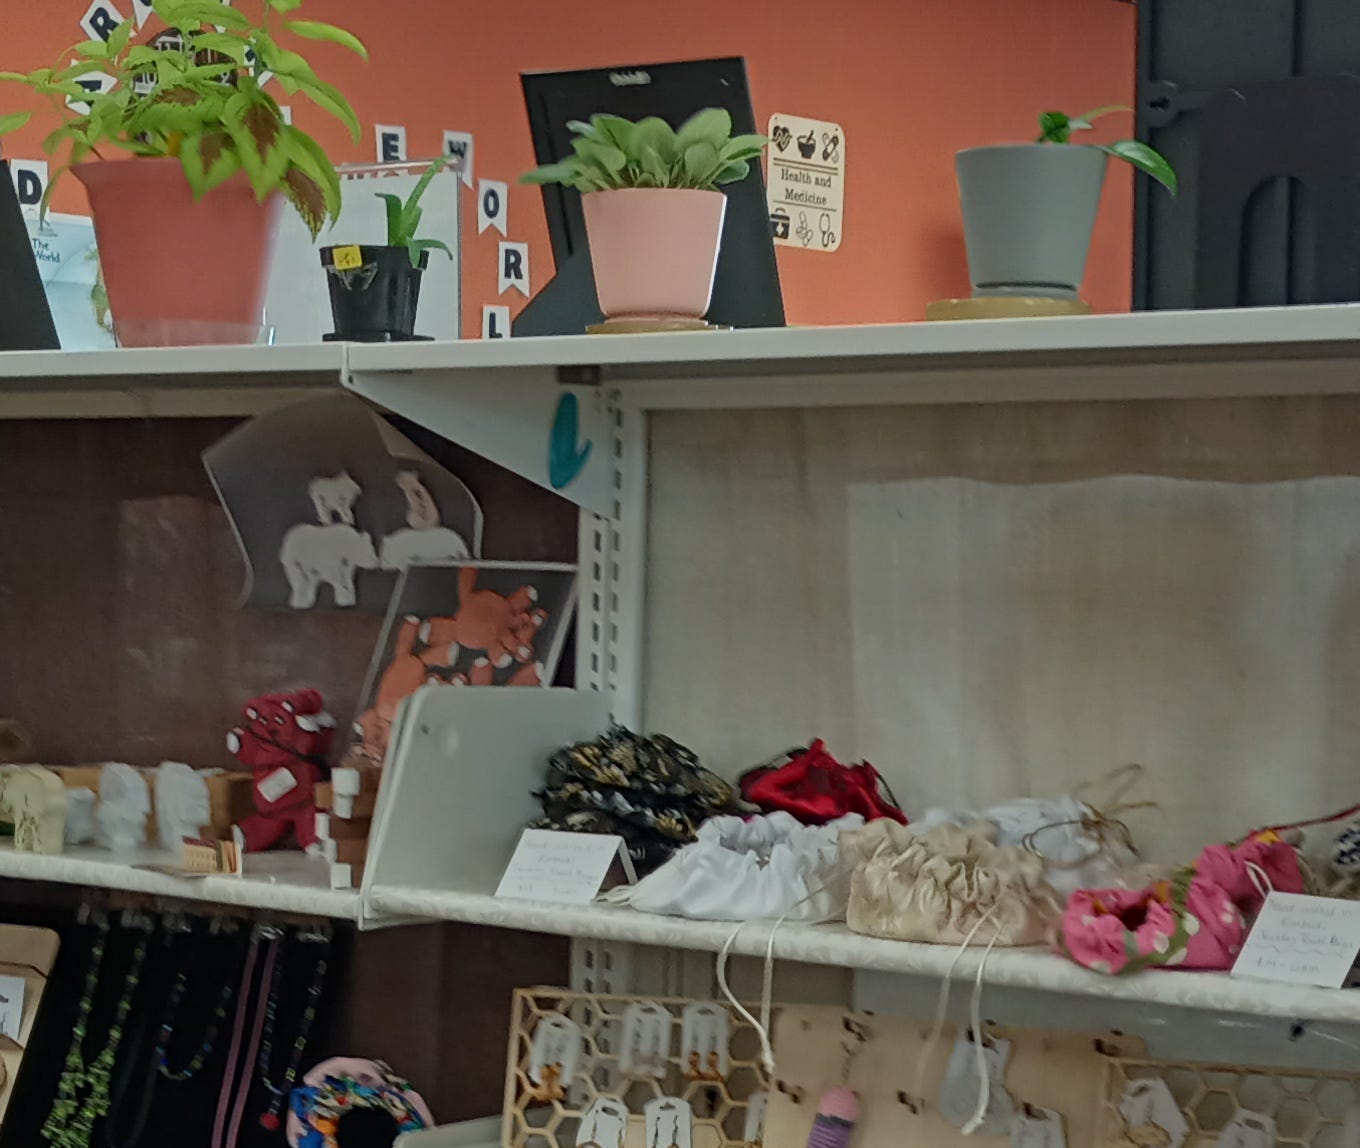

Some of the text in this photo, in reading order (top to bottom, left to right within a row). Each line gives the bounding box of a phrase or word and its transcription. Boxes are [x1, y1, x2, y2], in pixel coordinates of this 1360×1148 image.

[780, 167, 832, 188] Health and
[784, 188, 827, 205] Medicine
